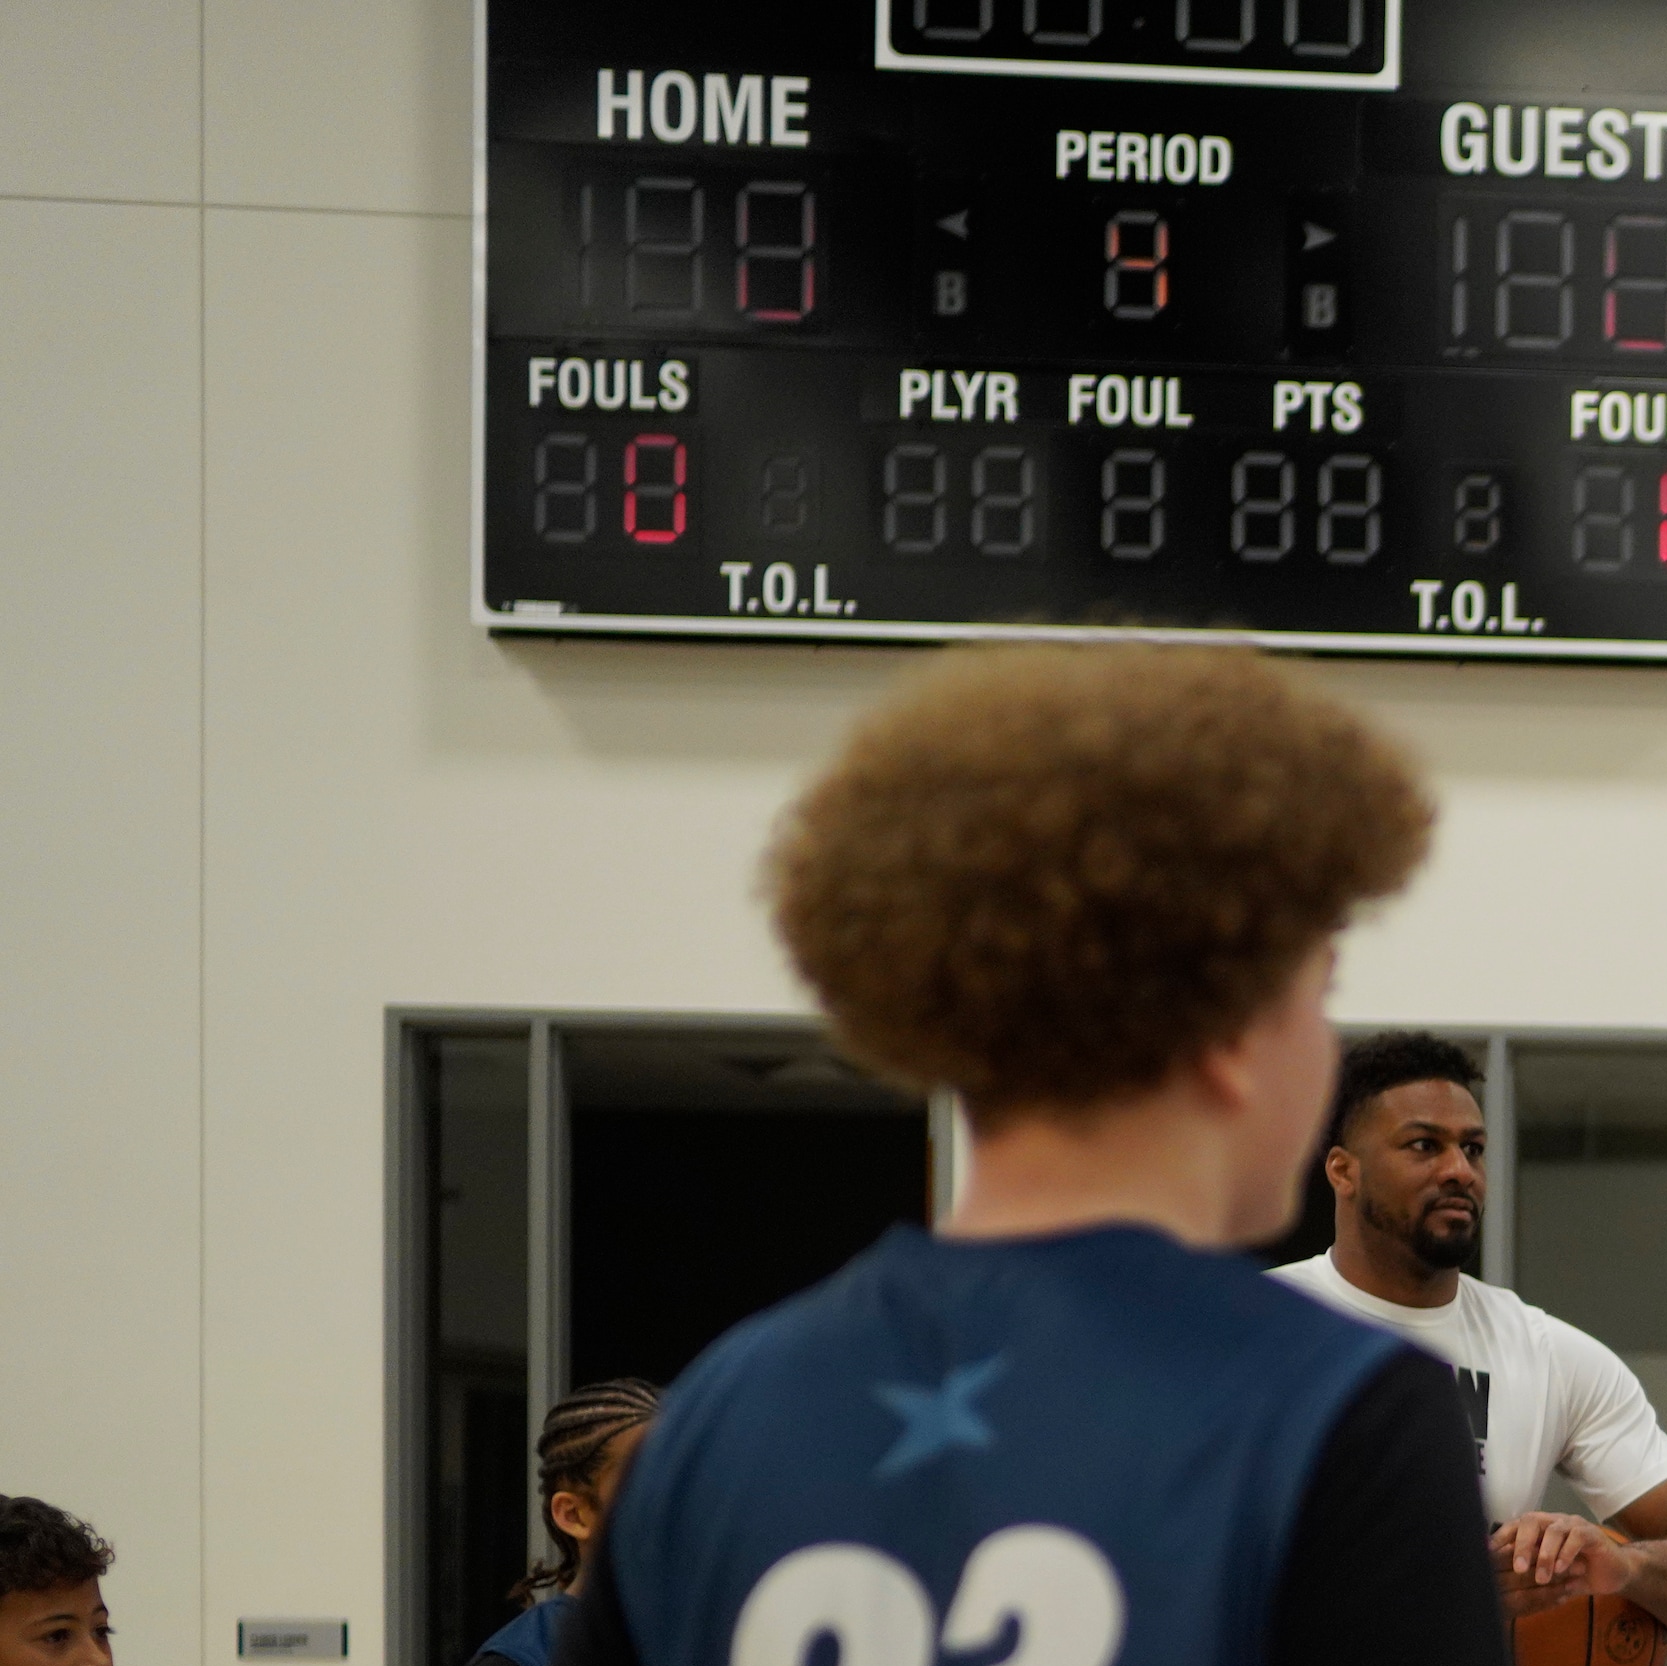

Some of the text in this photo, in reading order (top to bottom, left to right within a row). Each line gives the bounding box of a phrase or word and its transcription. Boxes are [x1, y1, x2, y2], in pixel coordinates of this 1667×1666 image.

[596, 69, 811, 148] HOME
[1056, 129, 1233, 185] PERIOD
[527, 357, 690, 414] FOULS
[899, 367, 1020, 422] PLYR
[1067, 374, 1195, 430] FOUL
[1272, 379, 1364, 435] PTS
[622, 432, 688, 545] 0
[719, 560, 858, 617] T.O.L.
[1410, 579, 1547, 634] T.O.L.
